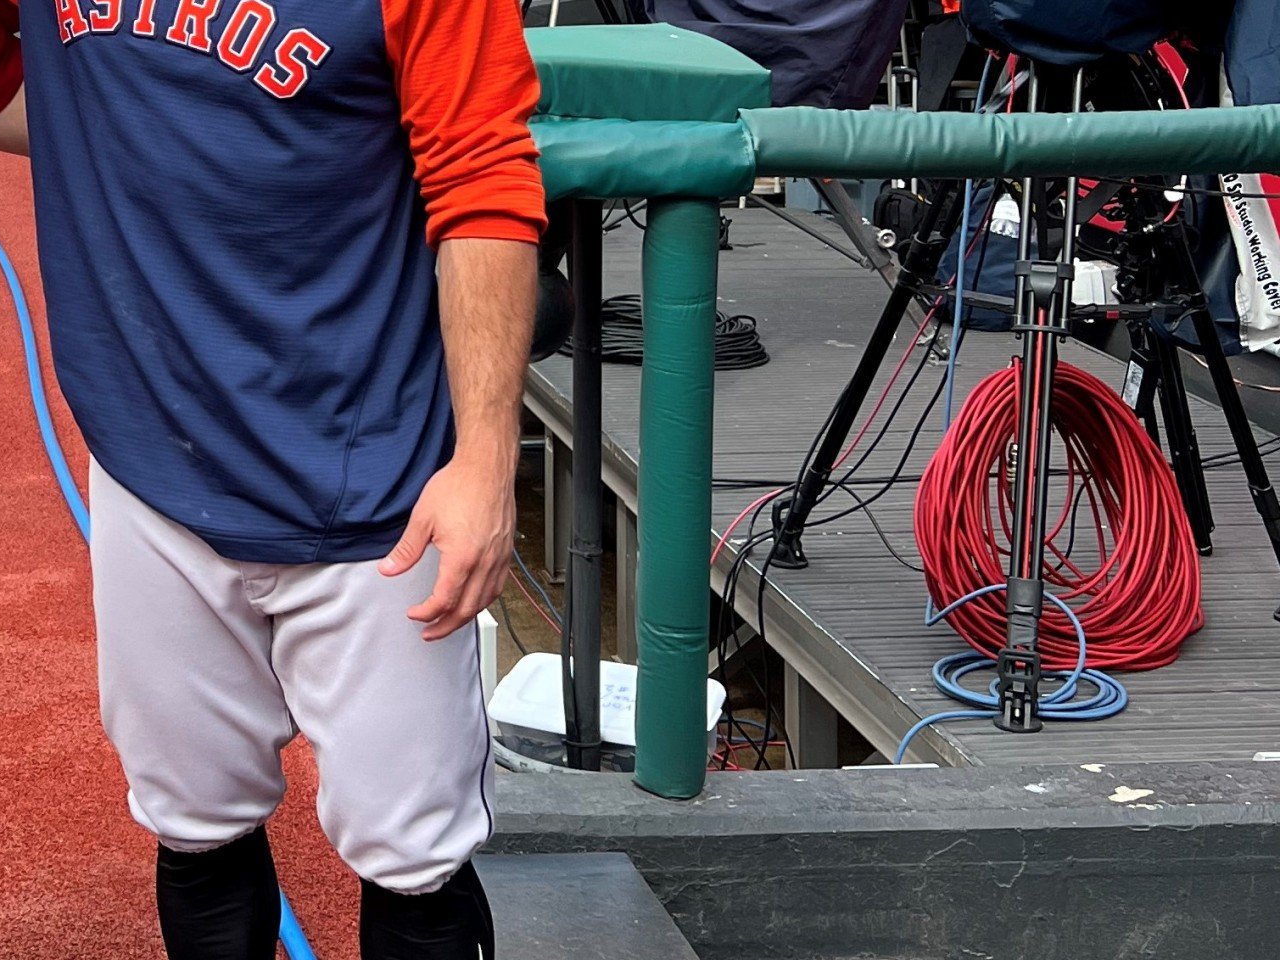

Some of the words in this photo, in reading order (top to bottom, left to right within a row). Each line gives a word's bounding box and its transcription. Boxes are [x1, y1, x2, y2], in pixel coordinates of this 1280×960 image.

[1235, 200, 1254, 237] Studio
[1248, 234, 1272, 282] Working
[1262, 281, 1280, 310] Cover
